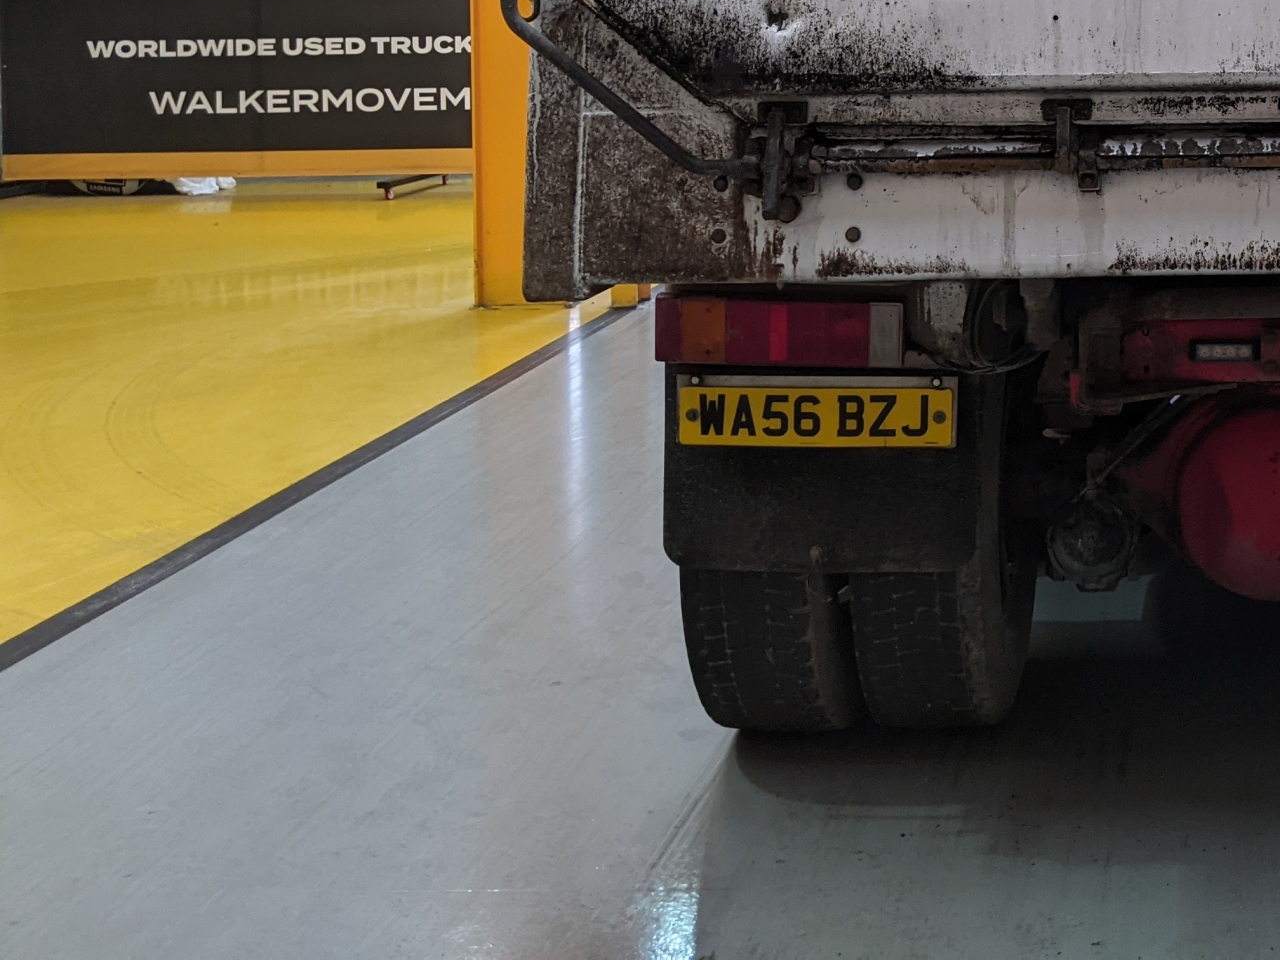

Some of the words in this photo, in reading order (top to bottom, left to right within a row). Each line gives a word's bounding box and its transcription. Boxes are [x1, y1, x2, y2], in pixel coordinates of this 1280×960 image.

[86, 39, 276, 59] WORLDWIDE
[282, 38, 366, 57] USED
[371, 35, 472, 56] TRUCK
[149, 86, 471, 116] WALKERMOVEM
[699, 393, 821, 437] WA56
[836, 395, 929, 437] BZJ
